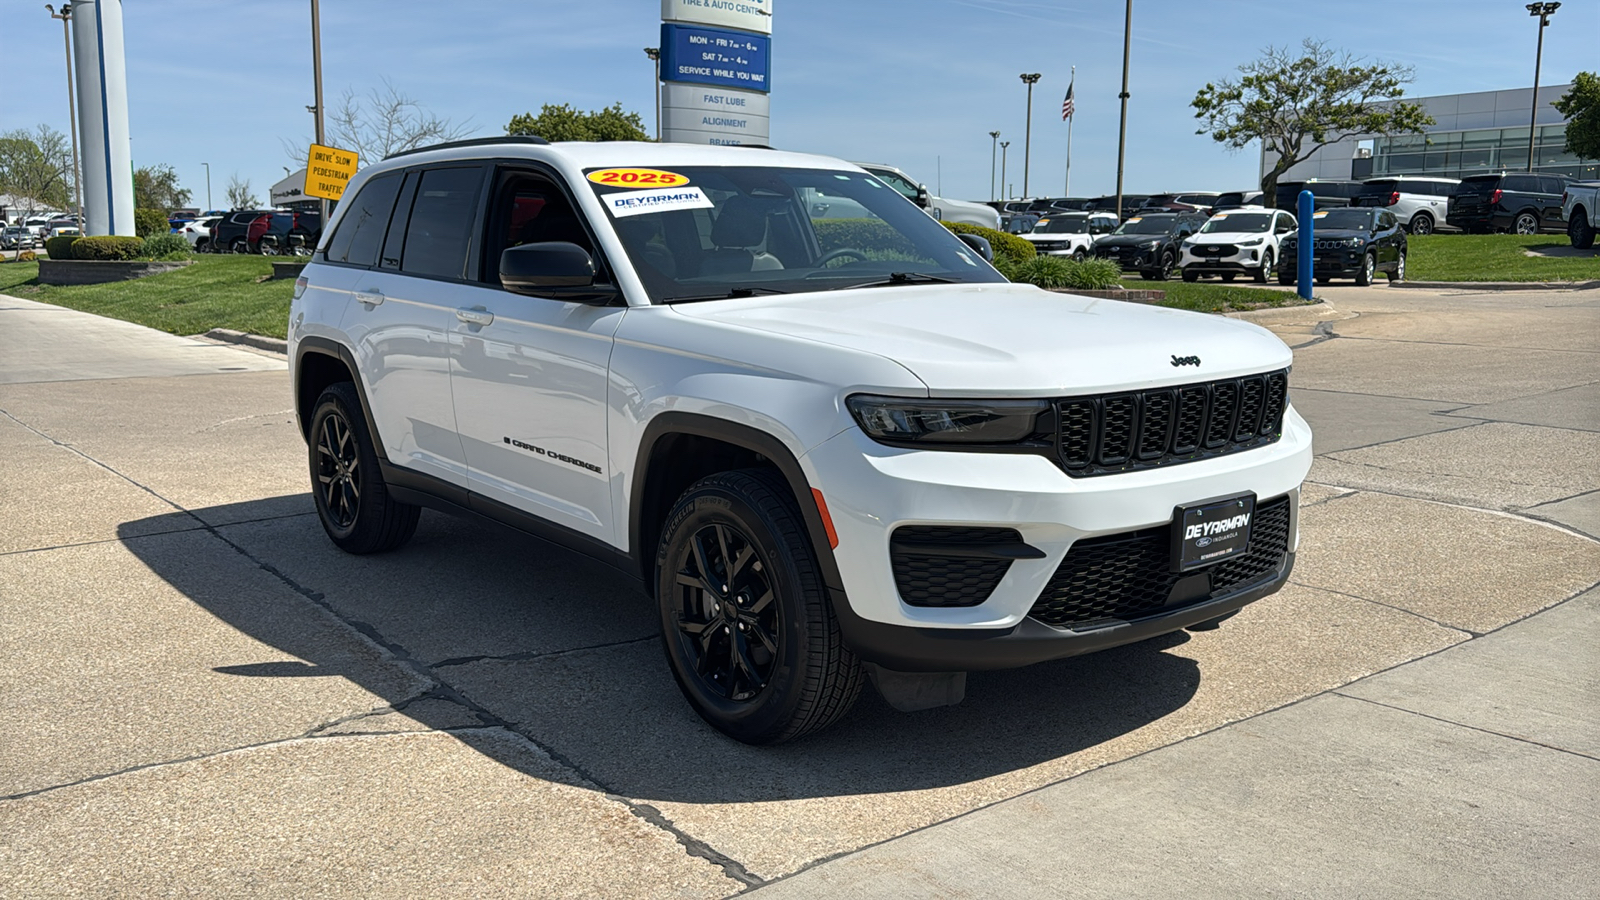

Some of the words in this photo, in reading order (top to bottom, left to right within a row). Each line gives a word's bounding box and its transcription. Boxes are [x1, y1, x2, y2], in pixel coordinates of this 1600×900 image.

[704, 0, 710, 8] &
[711, 1, 735, 11] AUTO
[736, 4, 763, 15] CENTE
[690, 36, 708, 44] MON
[716, 38, 728, 47] FRI
[702, 52, 716, 61] SAT
[679, 66, 711, 76] SERVICE
[713, 69, 734, 78] WHILE
[751, 73, 765, 82] WAIT
[704, 95, 724, 104] FAST
[725, 97, 746, 107] LUBE
[702, 117, 746, 128] ALIGNMENT
[315, 152, 332, 163] DRIVE
[336, 156, 351, 165] SLOW
[313, 167, 349, 180] PEDESTRIAN
[600, 172, 676, 183] 2025
[319, 183, 343, 194] TRAFFIC
[615, 193, 699, 206] DEYARMAN
[1170, 354, 1202, 368] Jeep
[512, 440, 545, 454] GRAND
[547, 450, 602, 474] CHEROKEE
[666, 502, 694, 542] MICHELIN
[1185, 513, 1250, 540] DEYARMAN
[1213, 532, 1238, 542] INDIANOLA
